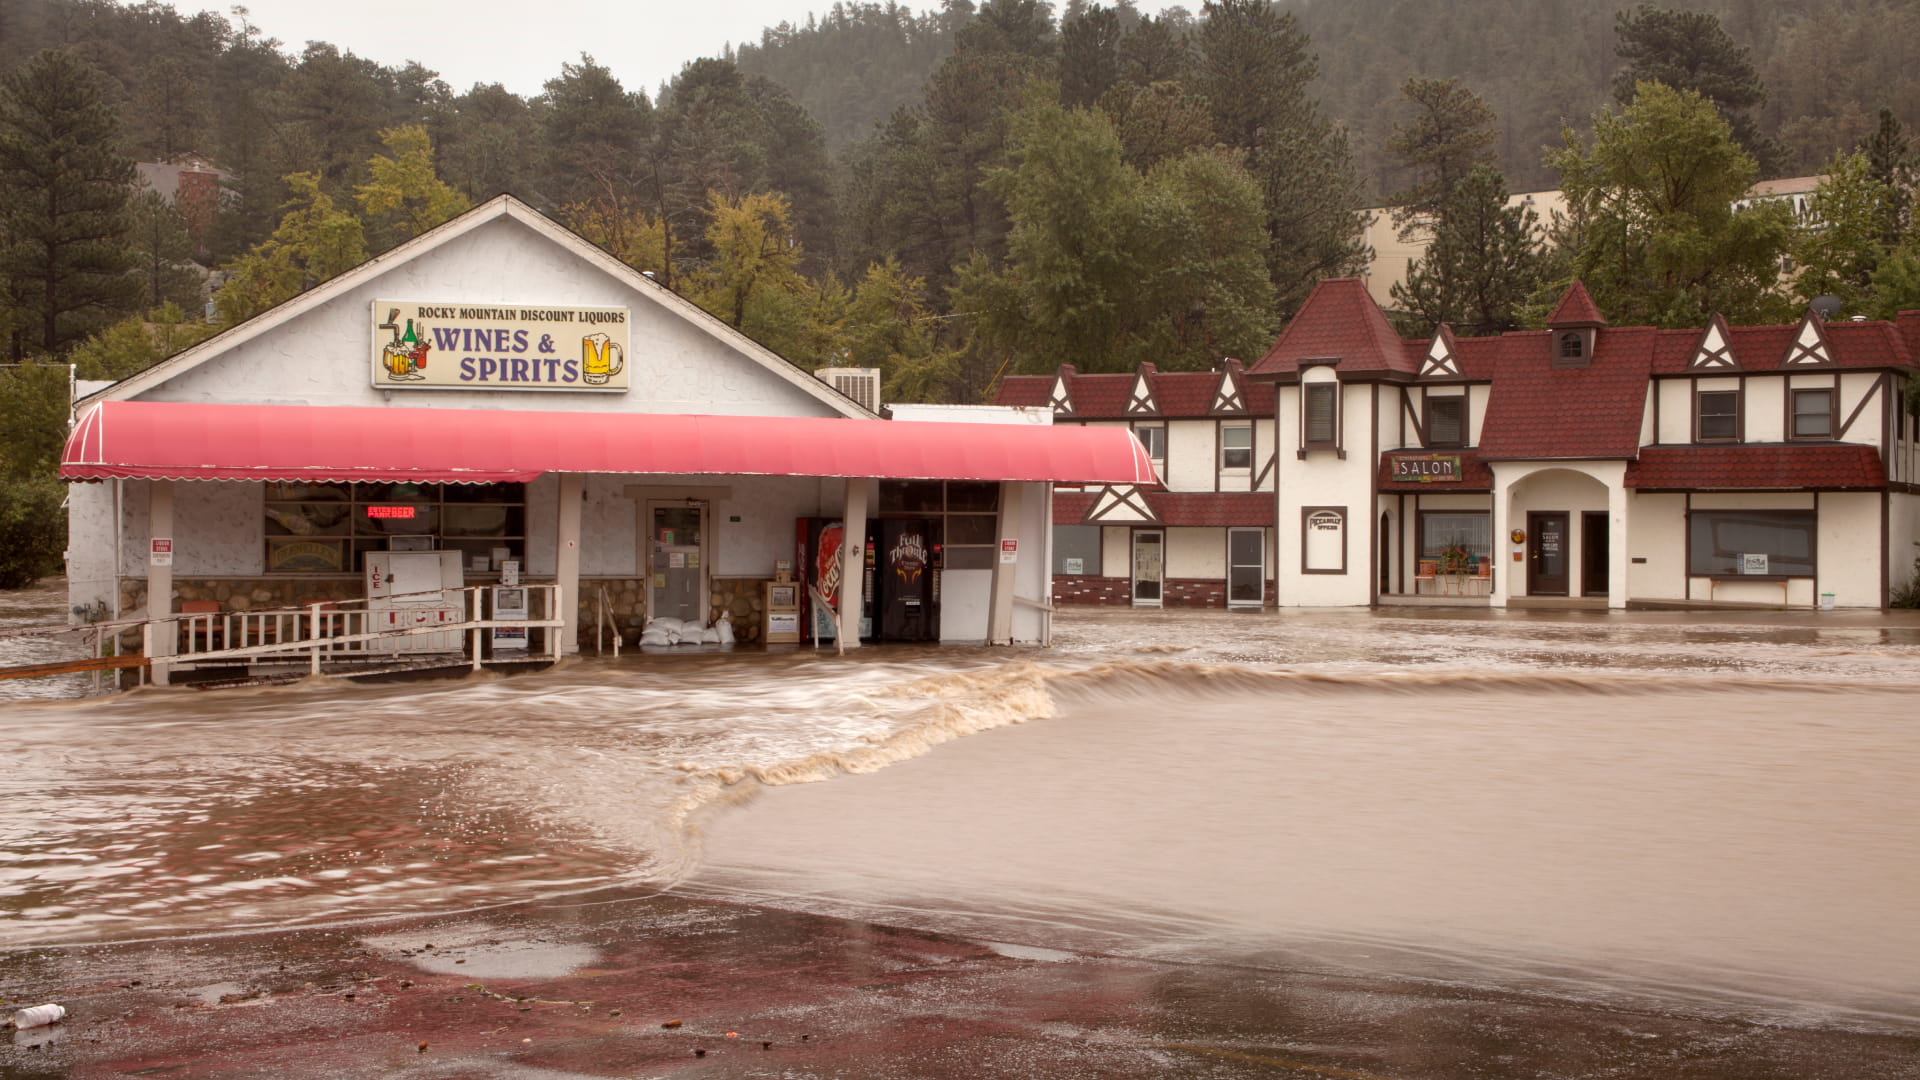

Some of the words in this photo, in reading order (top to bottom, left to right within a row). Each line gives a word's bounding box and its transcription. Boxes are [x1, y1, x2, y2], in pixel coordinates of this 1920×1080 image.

[418, 306, 456, 319] ROCKY
[459, 307, 517, 321] MOUNTAIN
[520, 309, 575, 323] DISCOUNT
[578, 310, 625, 325] LIQUORS
[432, 327, 529, 353] WINES
[538, 333, 556, 354] &
[459, 357, 579, 383] SPIRITS
[1400, 461, 1452, 475] SALON
[391, 506, 415, 518] BEER
[900, 533, 923, 547] Full
[372, 565, 381, 589] ICE
